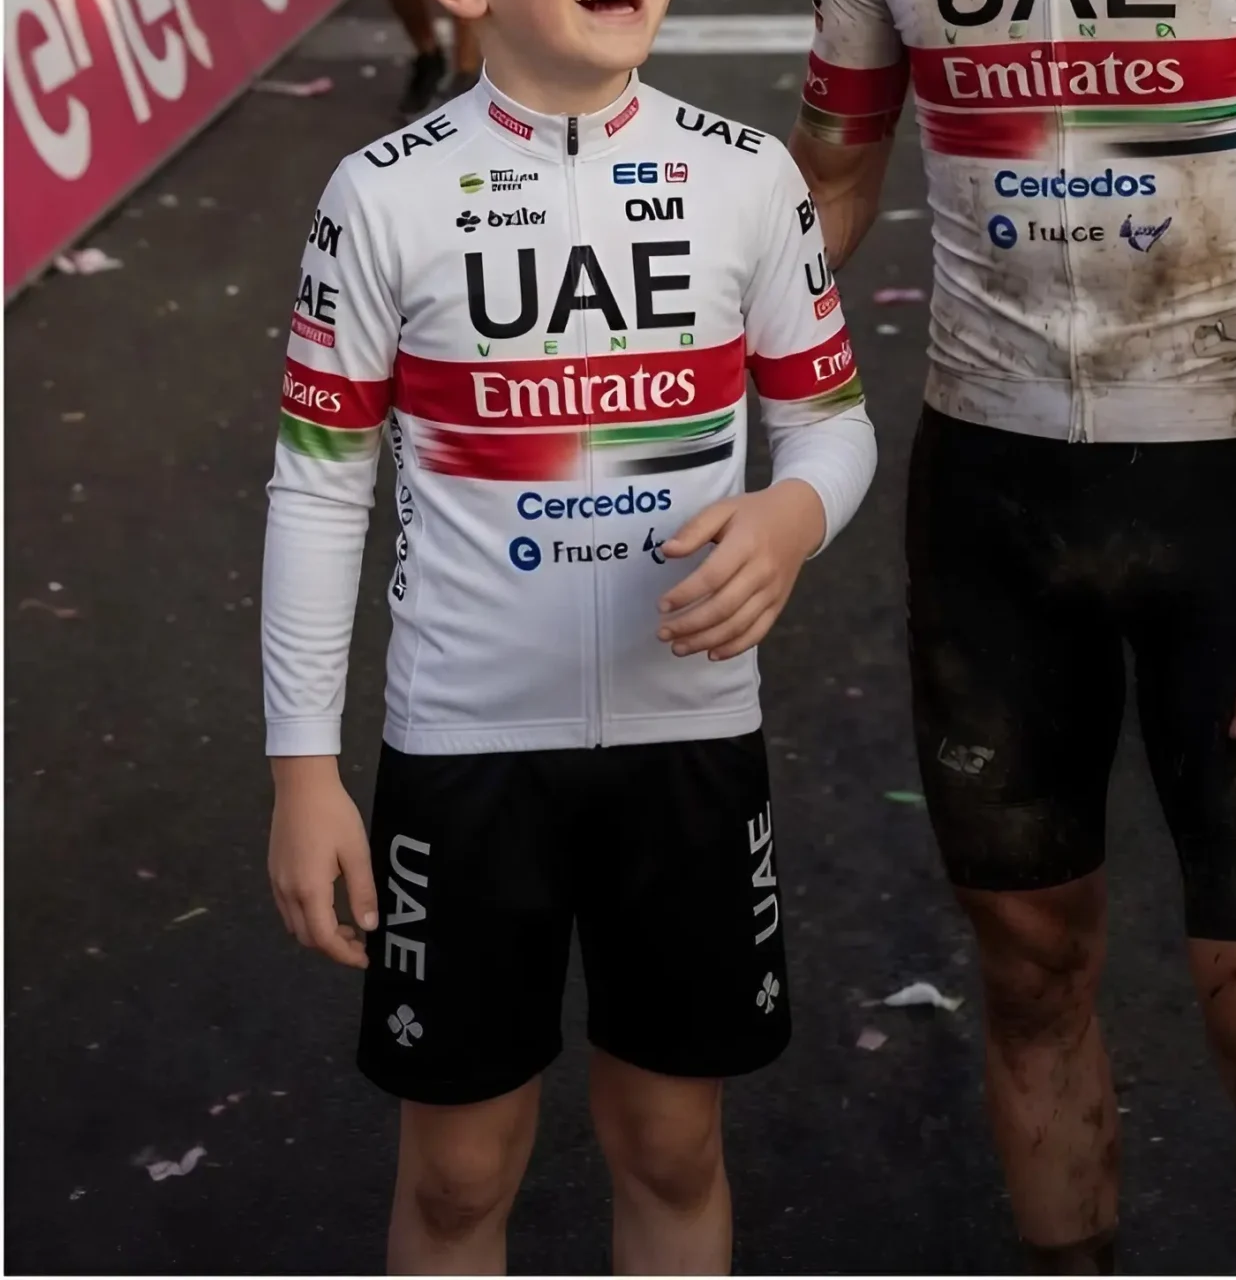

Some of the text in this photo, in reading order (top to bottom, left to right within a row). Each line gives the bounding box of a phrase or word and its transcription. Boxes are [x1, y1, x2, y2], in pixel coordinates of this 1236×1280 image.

[942, 50, 1185, 100] Emirates
[364, 113, 460, 169] UAE
[675, 107, 767, 155] UAE
[464, 241, 696, 340] UAE
[471, 365, 696, 418] Emirates
[517, 485, 672, 520] Cercedos
[747, 800, 779, 946] UAE
[384, 833, 432, 982] UAE
